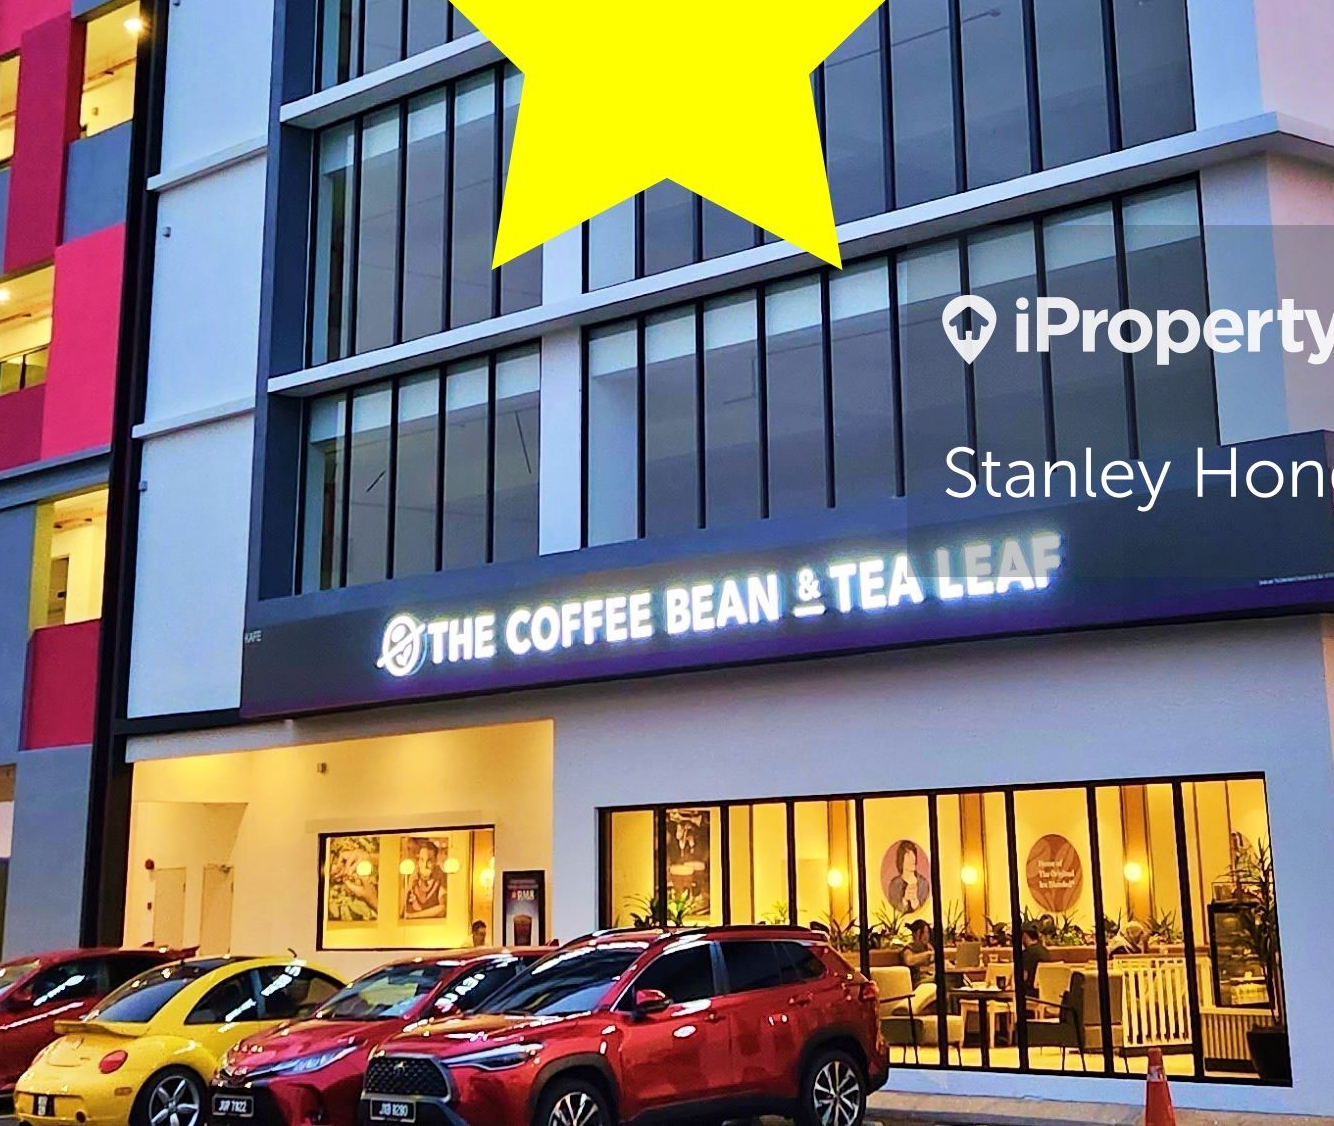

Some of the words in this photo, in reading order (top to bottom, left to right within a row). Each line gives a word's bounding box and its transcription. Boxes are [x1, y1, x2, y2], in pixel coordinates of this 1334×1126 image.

[426, 612, 496, 664] THE
[505, 592, 654, 657] COFFEE
[666, 573, 781, 635] BEAN
[827, 554, 925, 615] TEA
[935, 532, 1063, 601] LEAF
